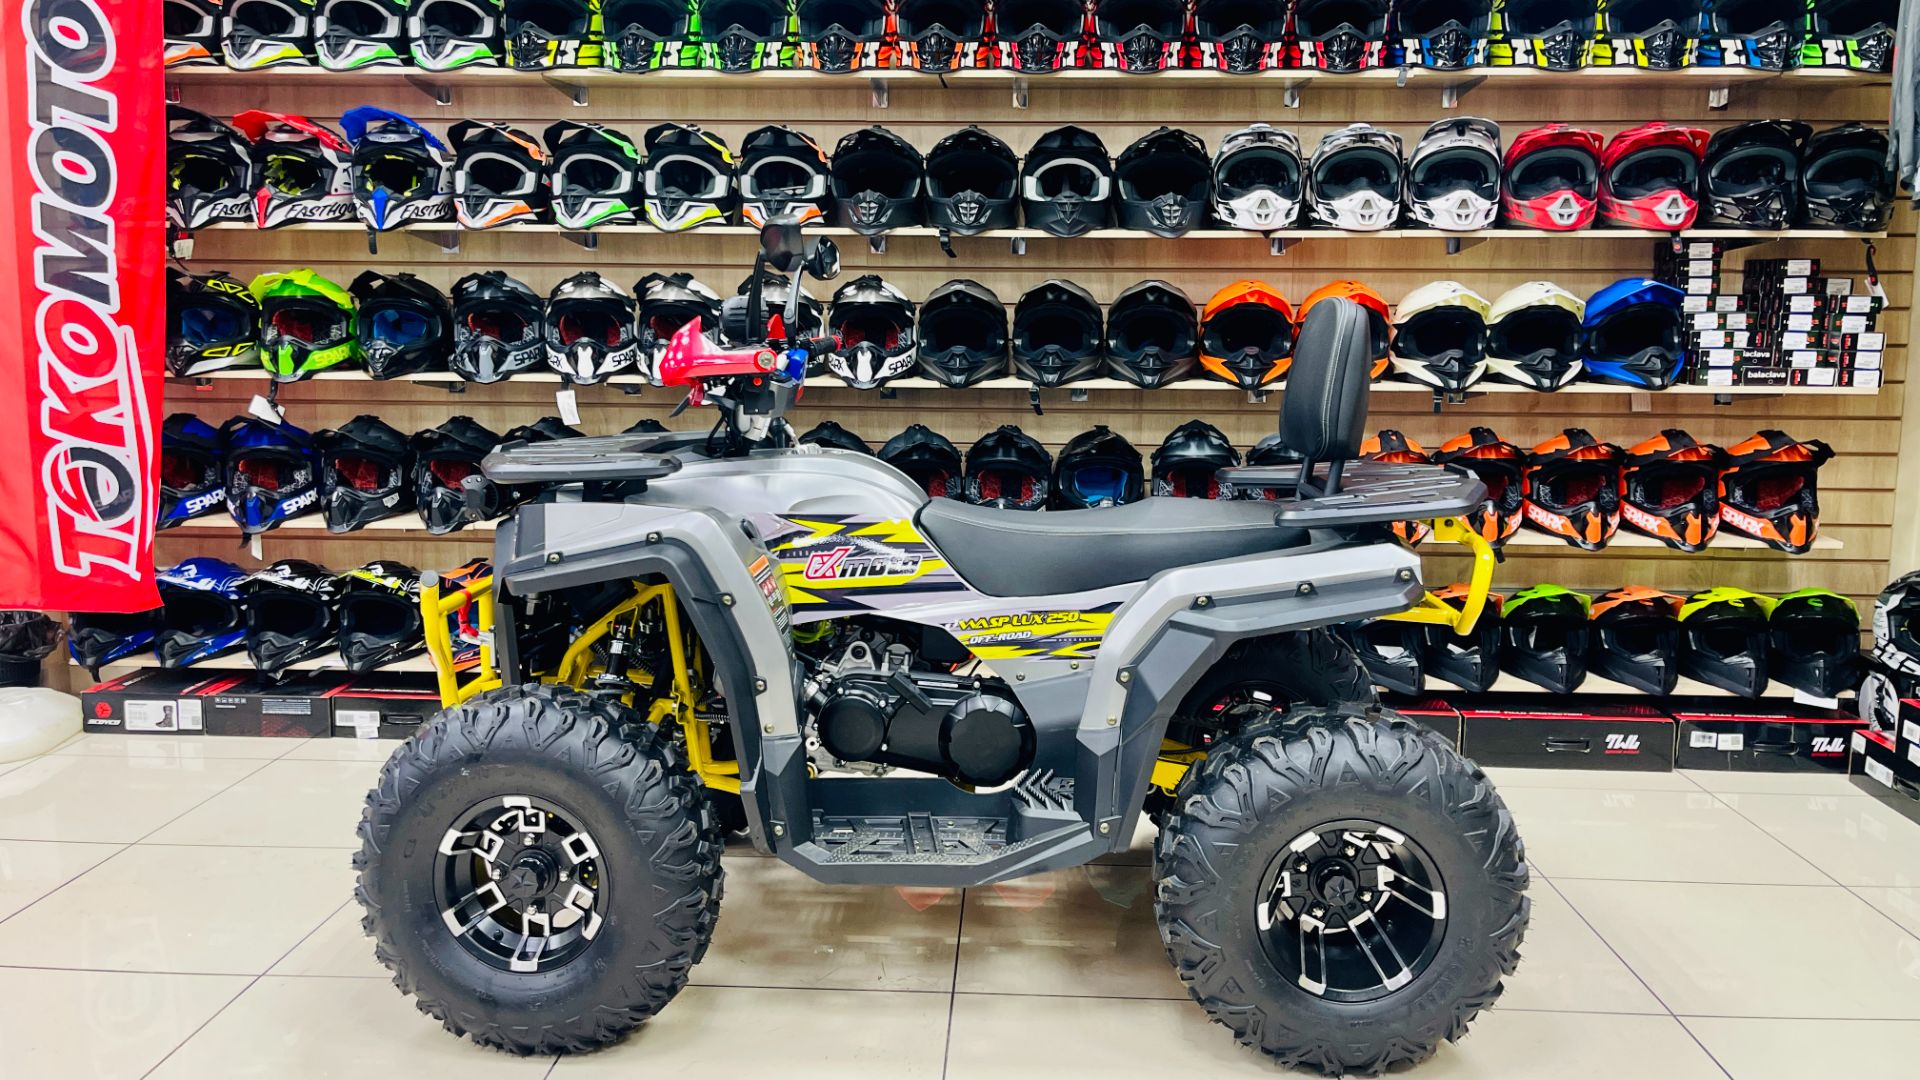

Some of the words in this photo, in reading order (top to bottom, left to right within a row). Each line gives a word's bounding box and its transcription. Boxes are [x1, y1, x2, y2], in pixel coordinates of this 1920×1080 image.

[1742, 350, 1771, 358] laclava
[1747, 371, 1786, 379] balaclava
[969, 631, 1032, 644] OFF-ROAD
